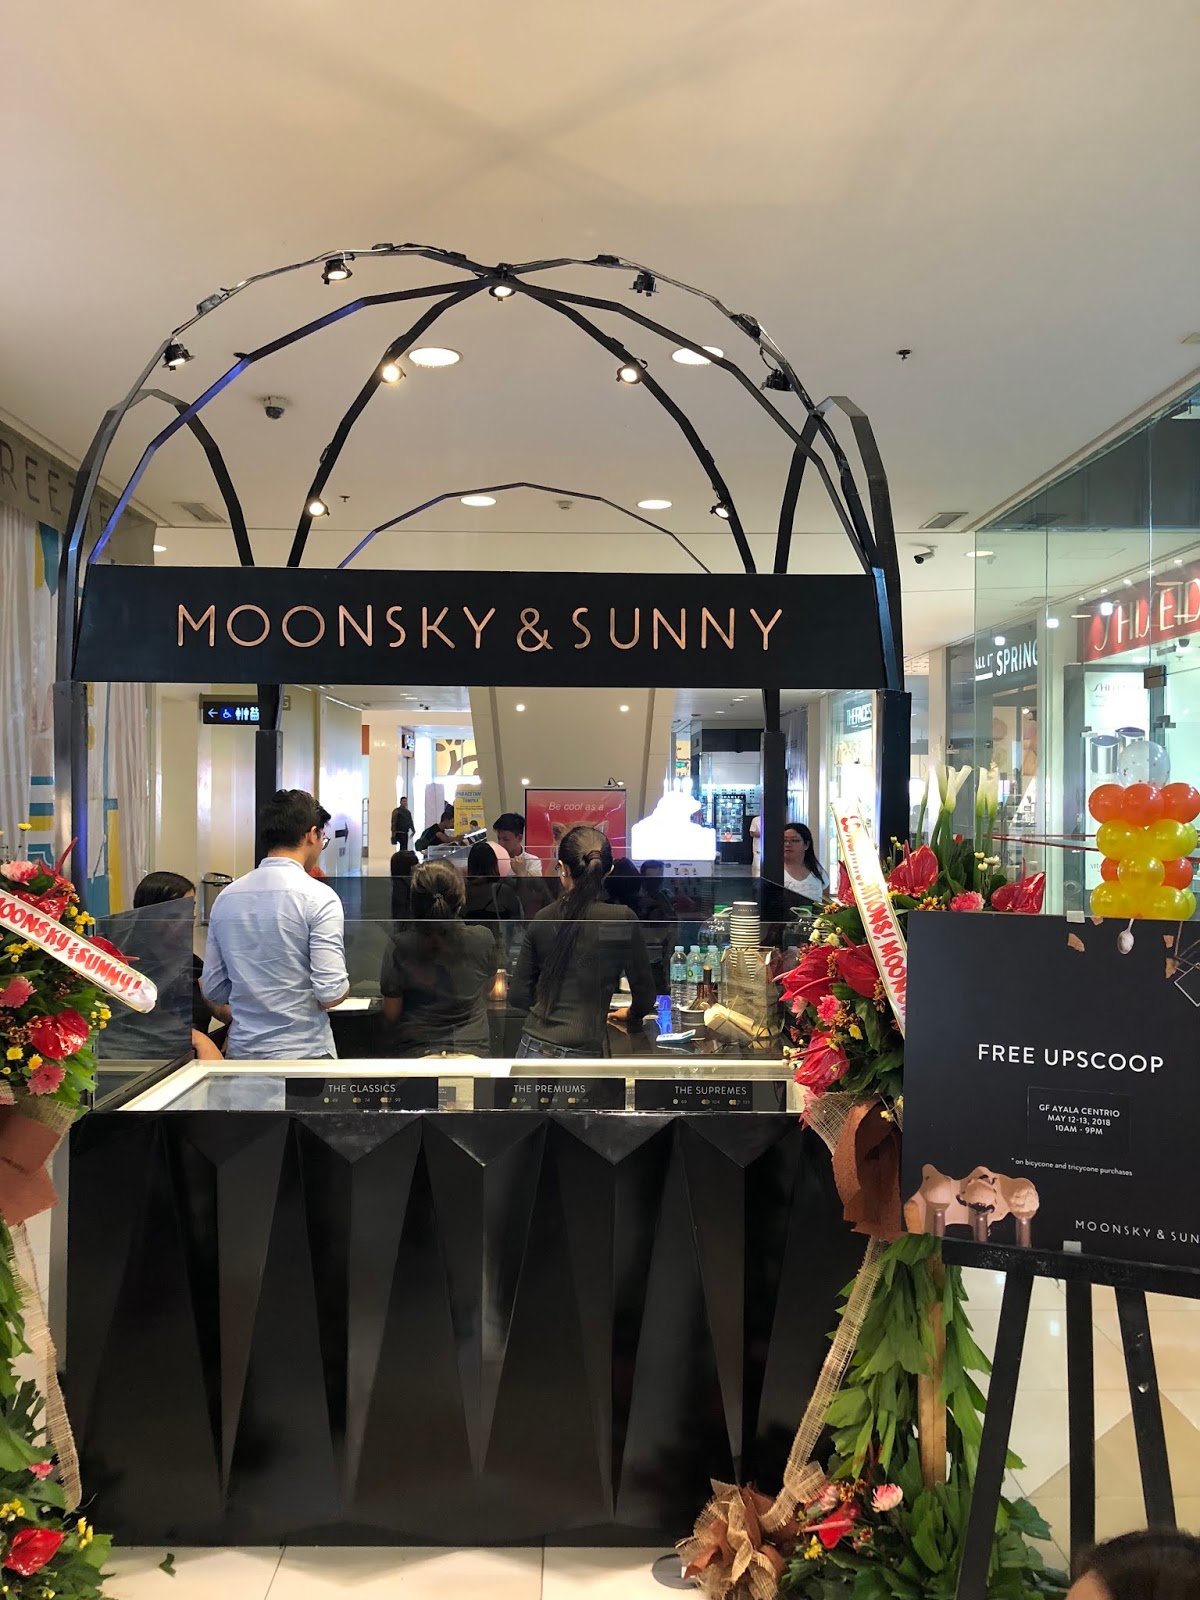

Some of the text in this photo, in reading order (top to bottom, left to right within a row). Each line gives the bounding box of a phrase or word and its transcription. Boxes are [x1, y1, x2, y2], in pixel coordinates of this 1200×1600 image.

[177, 604, 783, 653] MOONSKY & SUNNY
[549, 801, 562, 811] Be
[563, 802, 584, 811] cool
[978, 1043, 1164, 1073] FREE UPSCOOP
[328, 1084, 396, 1093] THE CLASSICS
[513, 1084, 586, 1093] THE PREMIUMS
[675, 1086, 747, 1095] THE SUPREMES
[1039, 1104, 1120, 1118] GF AYALA CENTRIO
[1047, 1114, 1111, 1126] MAY 12-13, 2018
[1085, 1127, 1103, 1135] 9PM
[1025, 1159, 1053, 1168] bicycone
[1068, 1164, 1099, 1173] tricycone
[1100, 1168, 1132, 1176] purchases
[1075, 1220, 1200, 1244] MOONSKY & SUN
